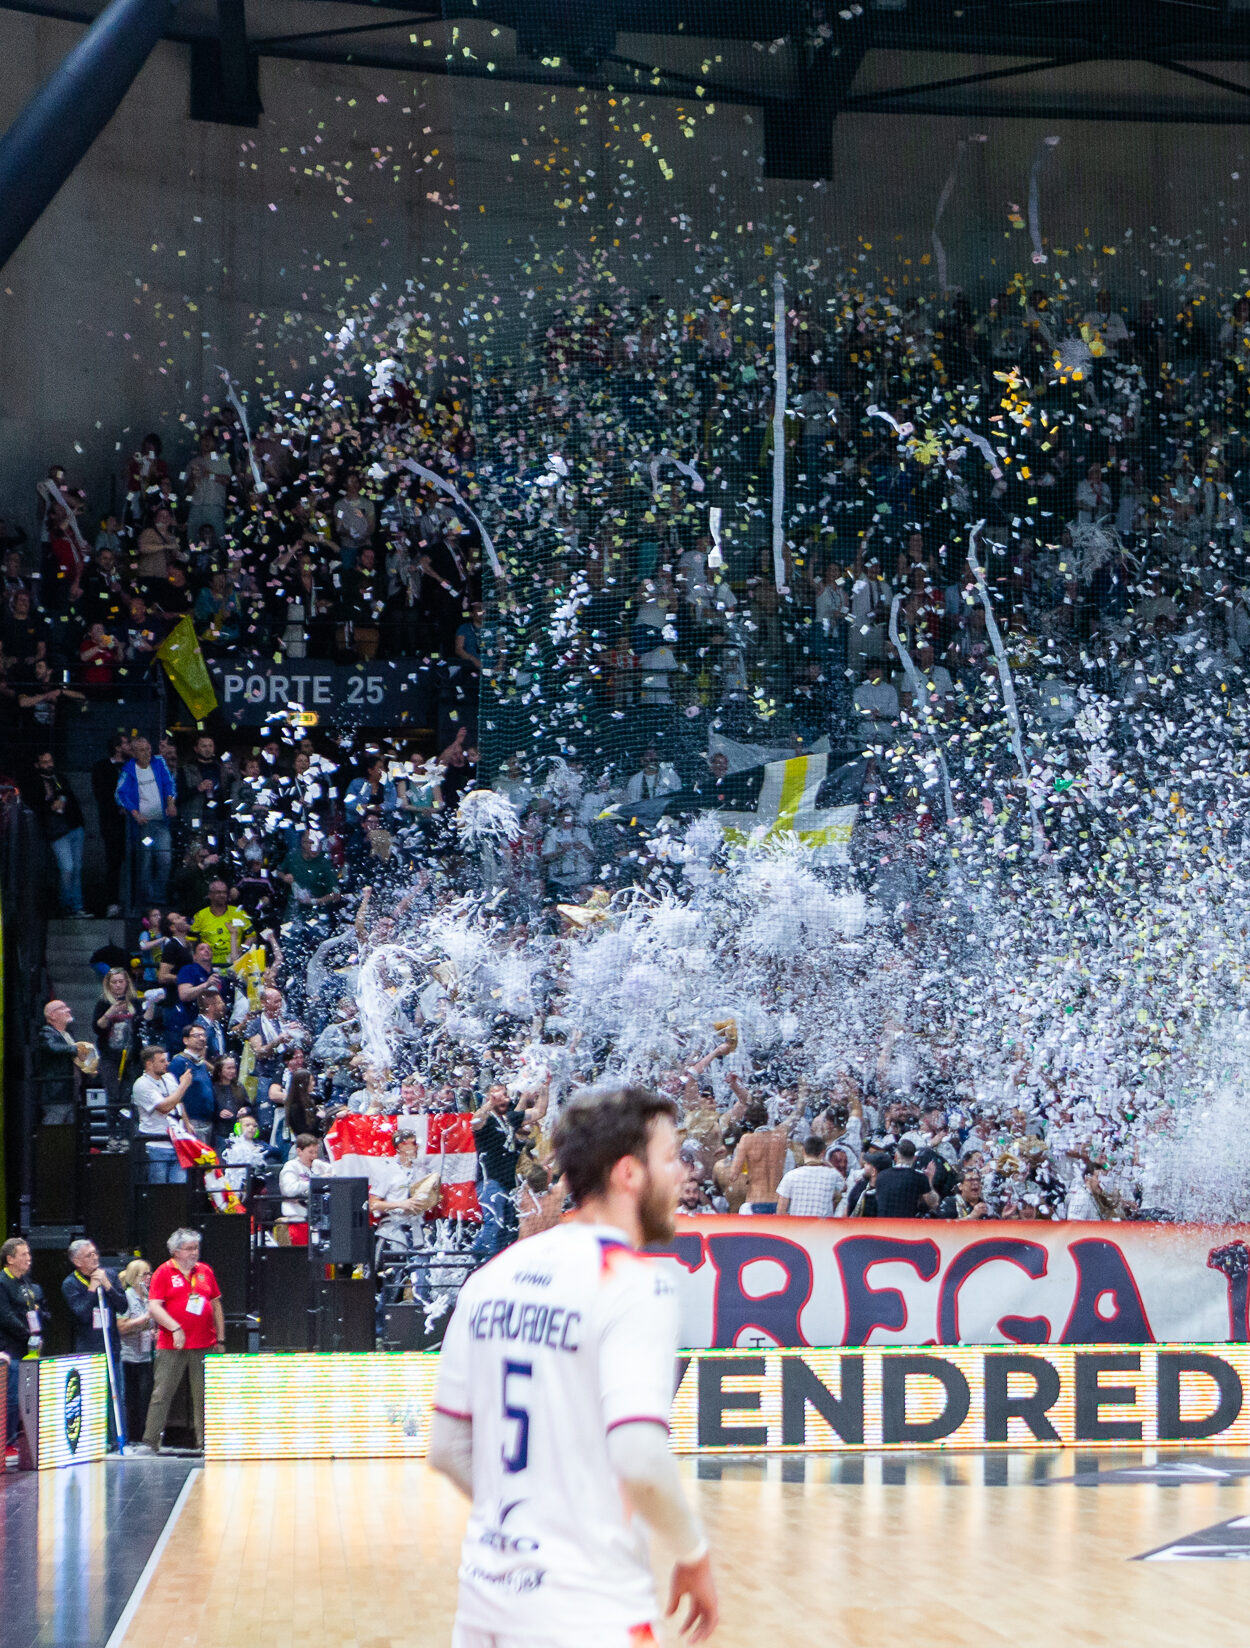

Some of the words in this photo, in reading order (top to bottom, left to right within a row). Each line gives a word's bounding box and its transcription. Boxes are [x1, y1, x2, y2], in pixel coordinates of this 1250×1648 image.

[224, 674, 331, 703] PORTE
[347, 675, 383, 704] 25
[648, 1231, 1157, 1348] REGA
[501, 1359, 533, 1473] 5
